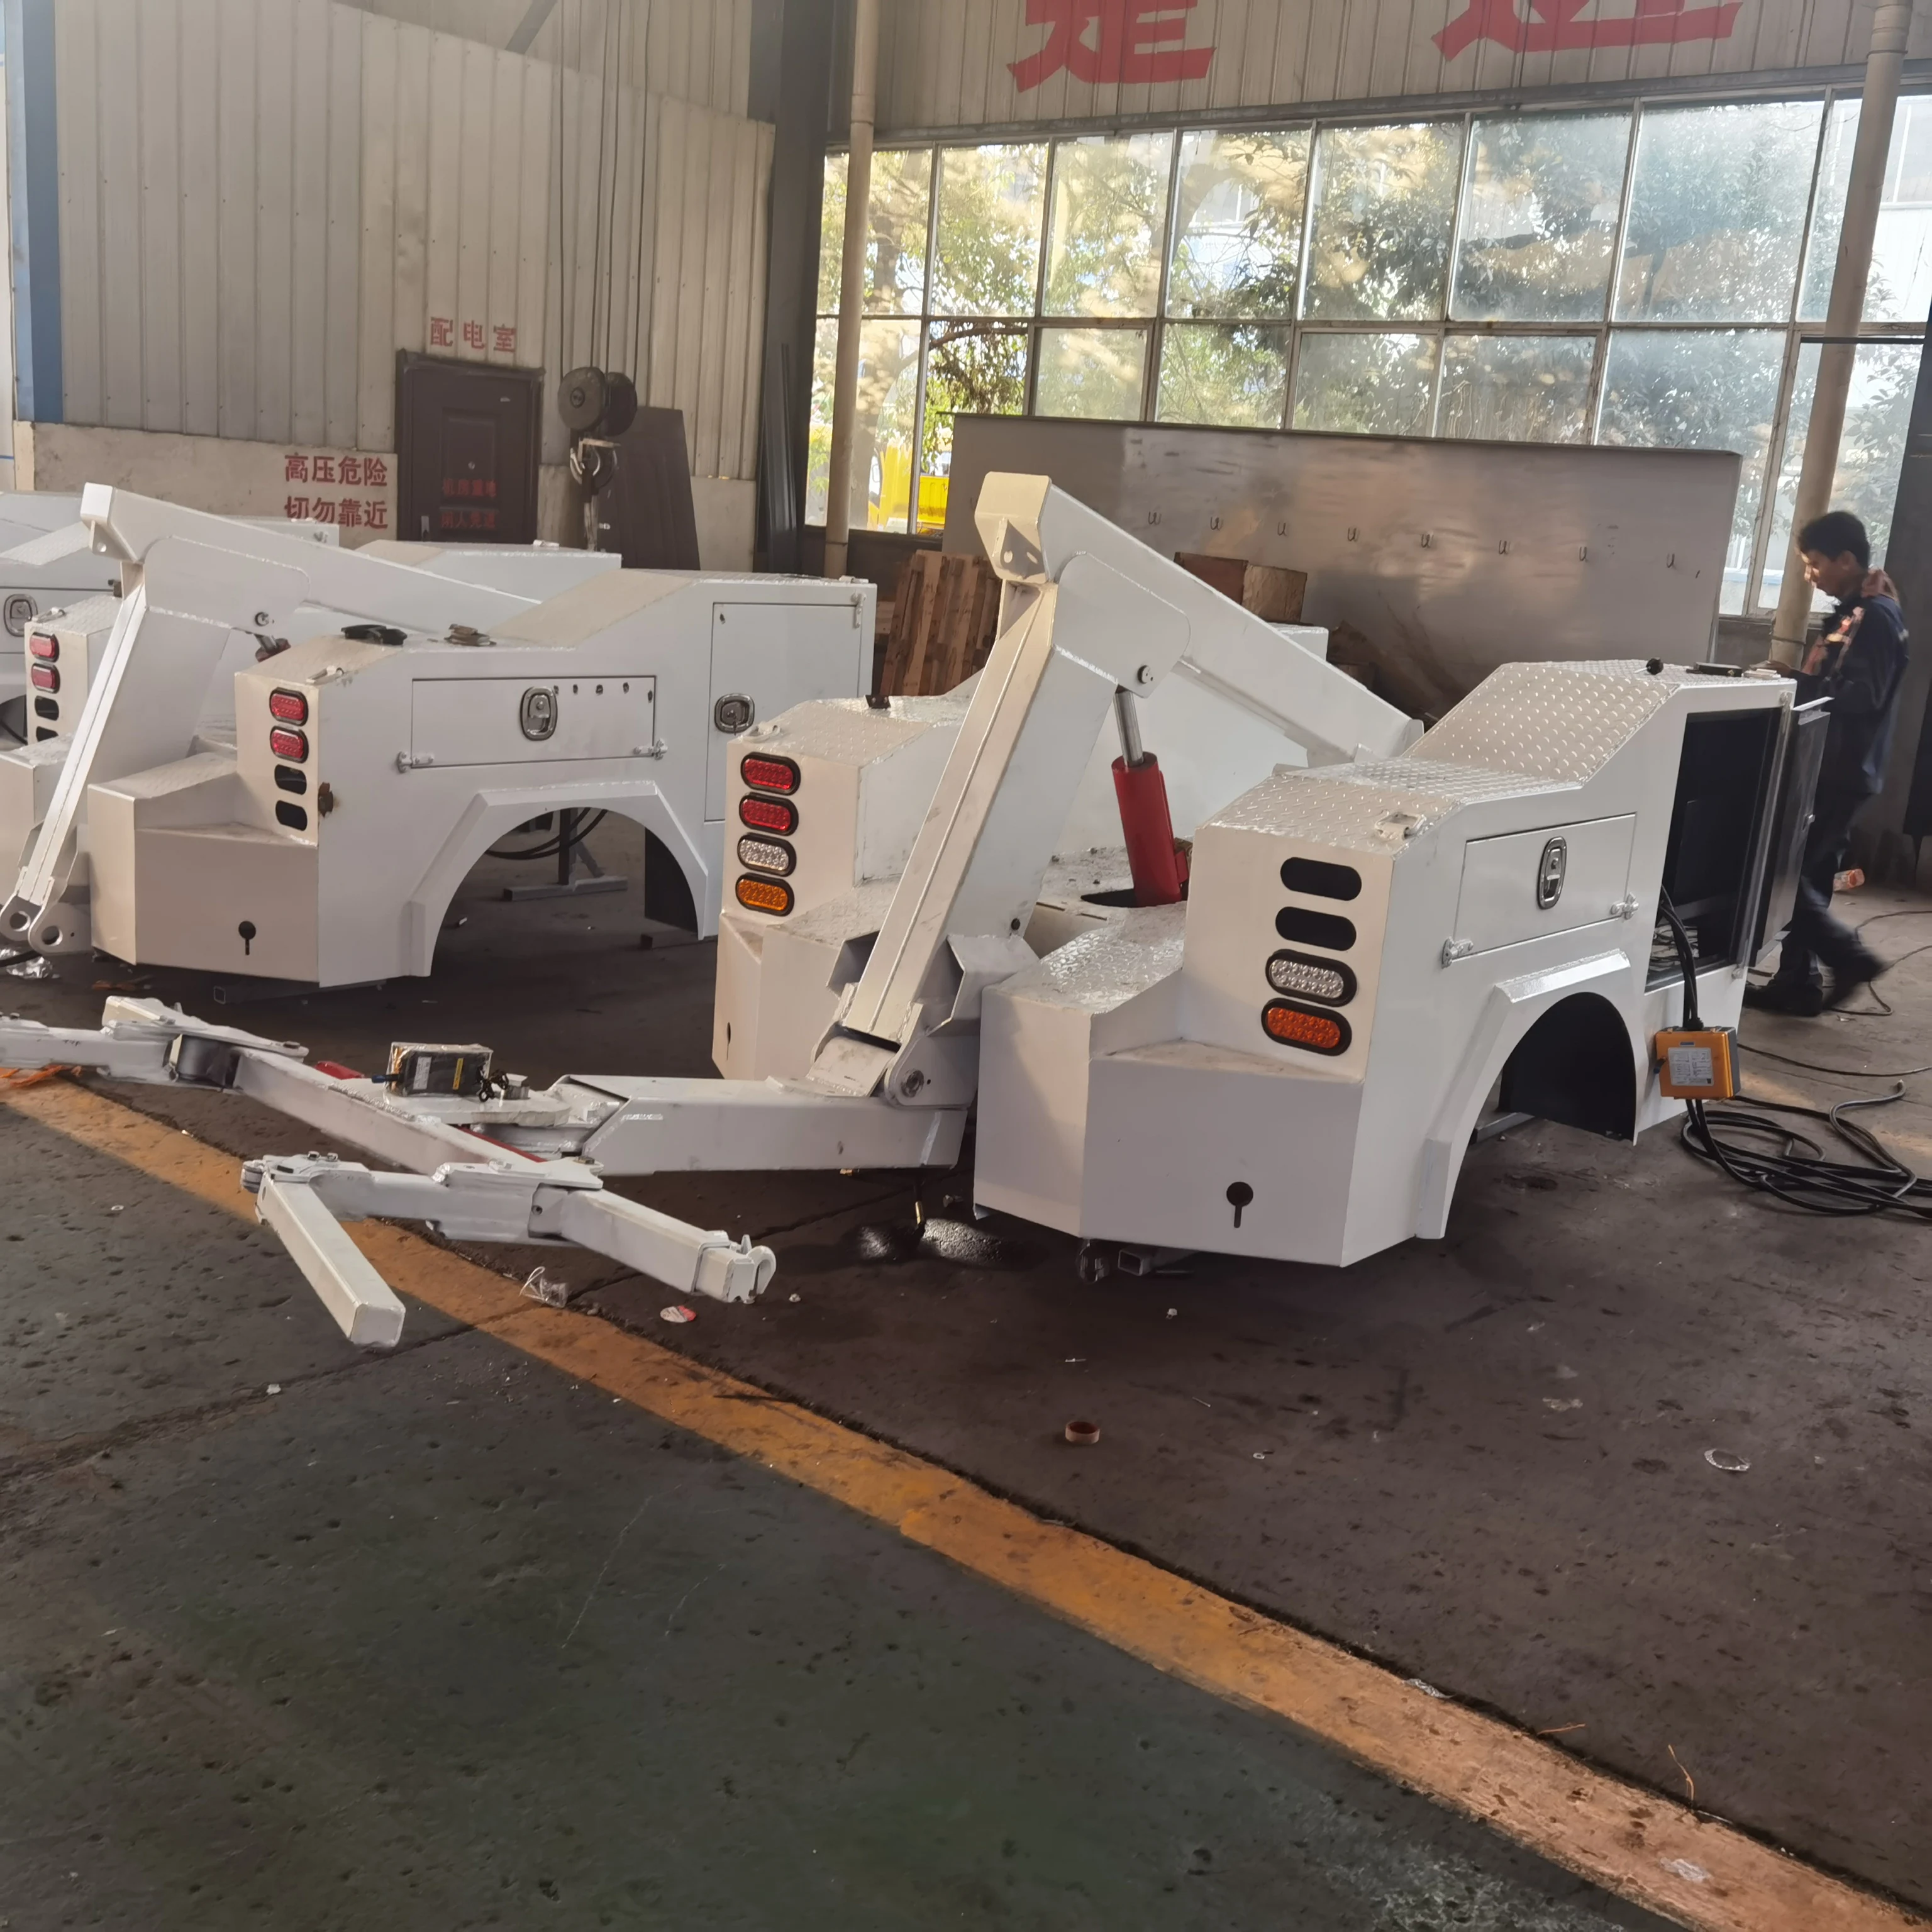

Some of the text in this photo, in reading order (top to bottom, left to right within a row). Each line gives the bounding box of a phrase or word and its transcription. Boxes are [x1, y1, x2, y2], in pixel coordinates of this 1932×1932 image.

[430, 316, 516, 353] 配电室
[284, 453, 387, 487] 高压危险
[284, 497, 388, 529] 切勿靠近
